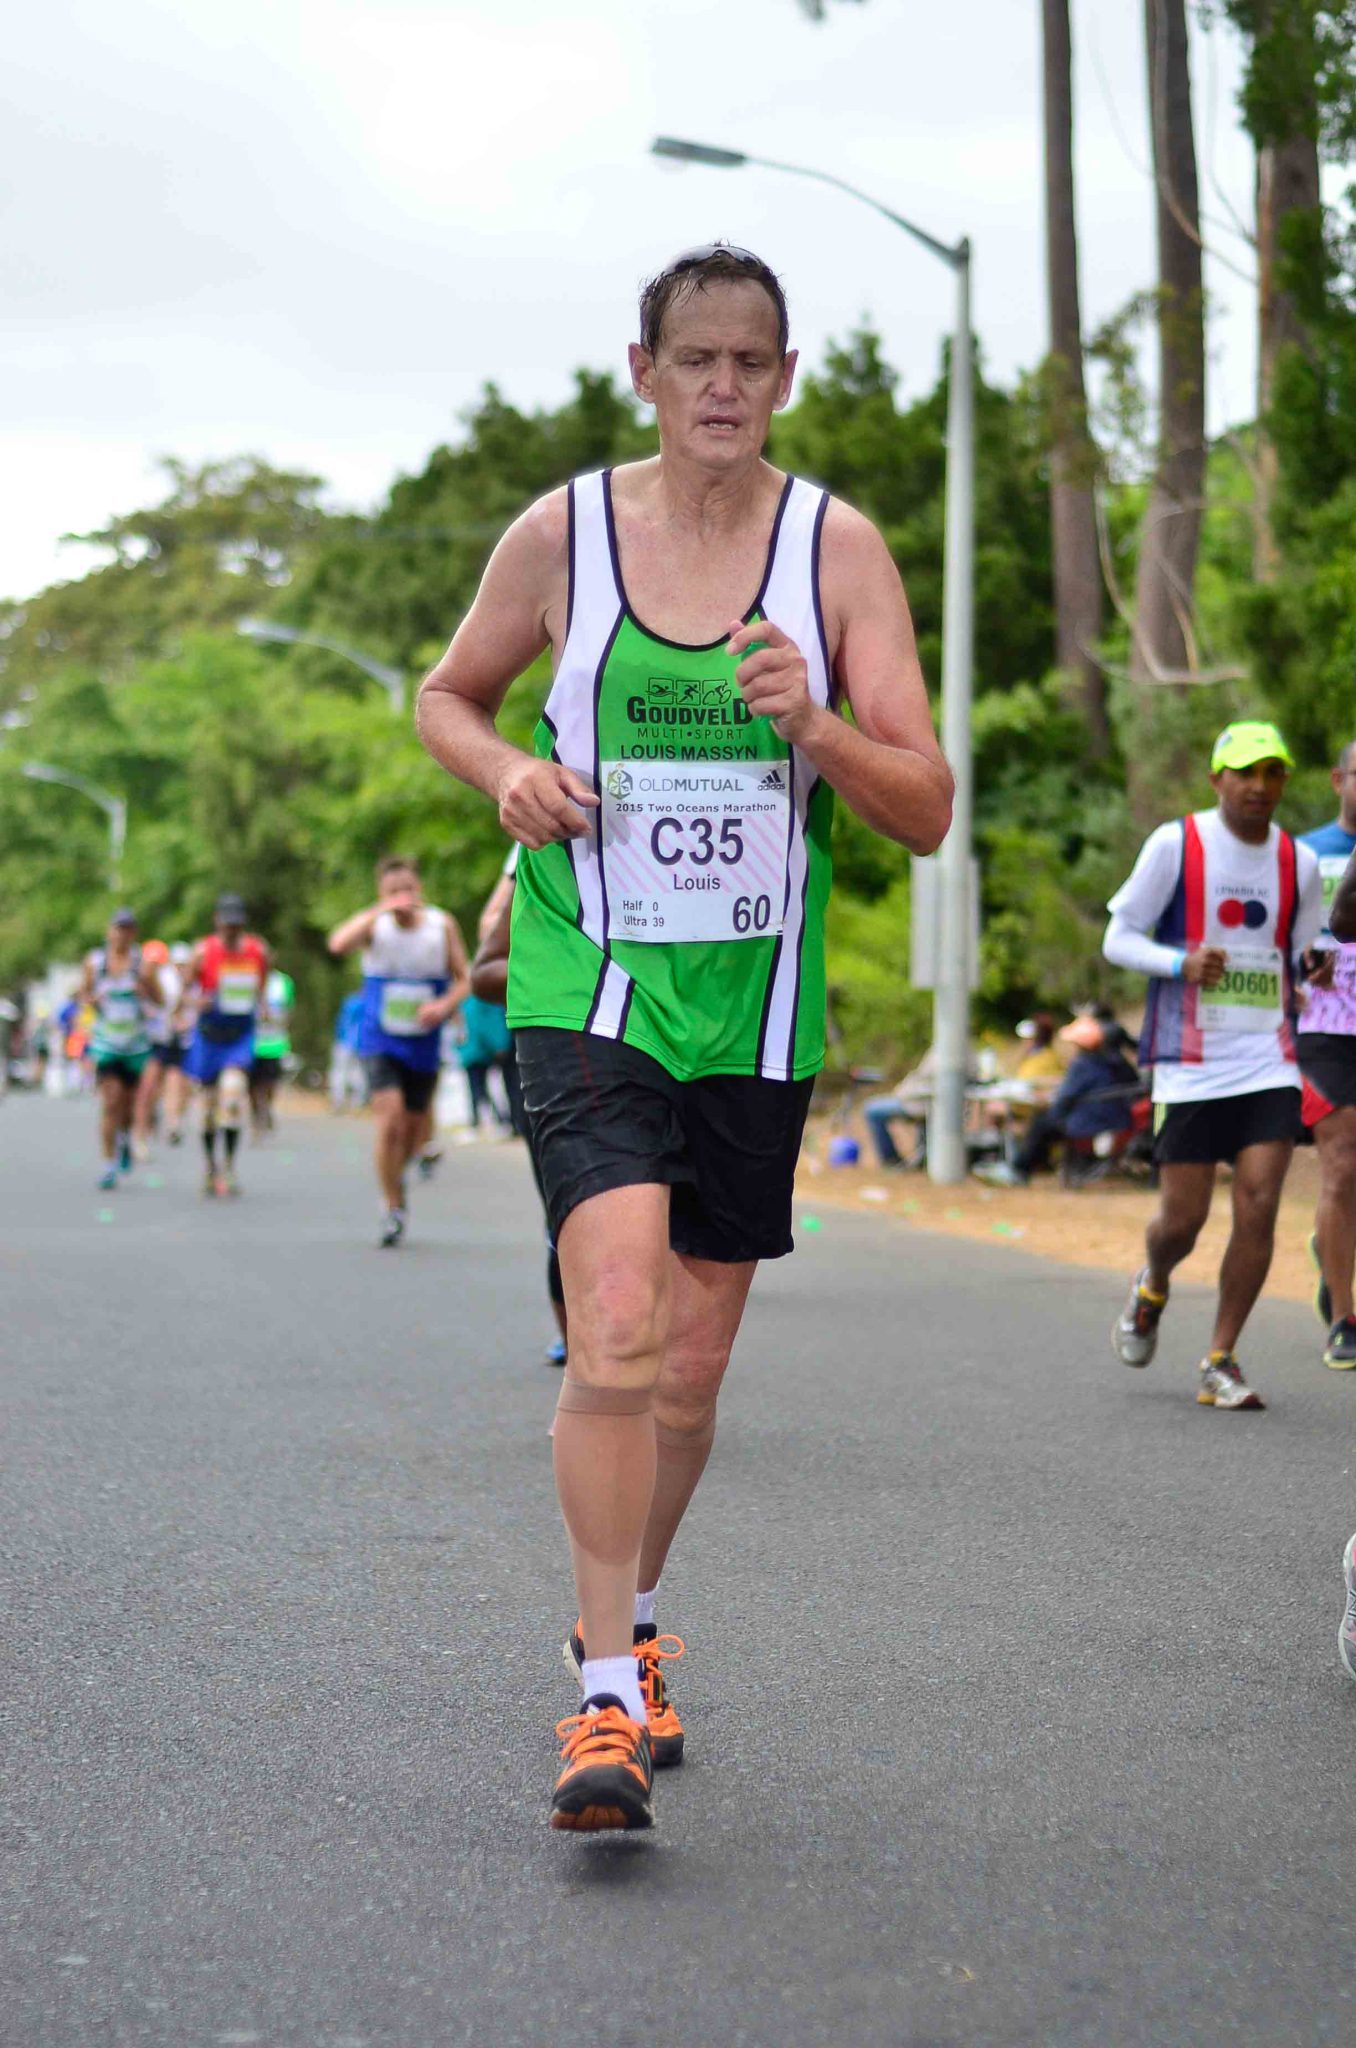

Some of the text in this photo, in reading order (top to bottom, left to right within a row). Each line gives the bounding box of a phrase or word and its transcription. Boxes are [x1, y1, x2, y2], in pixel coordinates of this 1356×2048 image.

[627, 696, 753, 726] GOUDVELD
[620, 744, 758, 761] LOUIS MASSYN
[639, 778, 744, 792] OLDMUTUAL
[757, 783, 786, 791] adidas
[616, 802, 776, 812] 2015 Two Oceans Marathon
[651, 817, 744, 866] C35
[673, 873, 721, 890] Louis
[622, 900, 659, 912] Half 0
[732, 894, 771, 933] 60
[624, 915, 665, 927] Ultra 39
[1201, 971, 1278, 996] 30601
